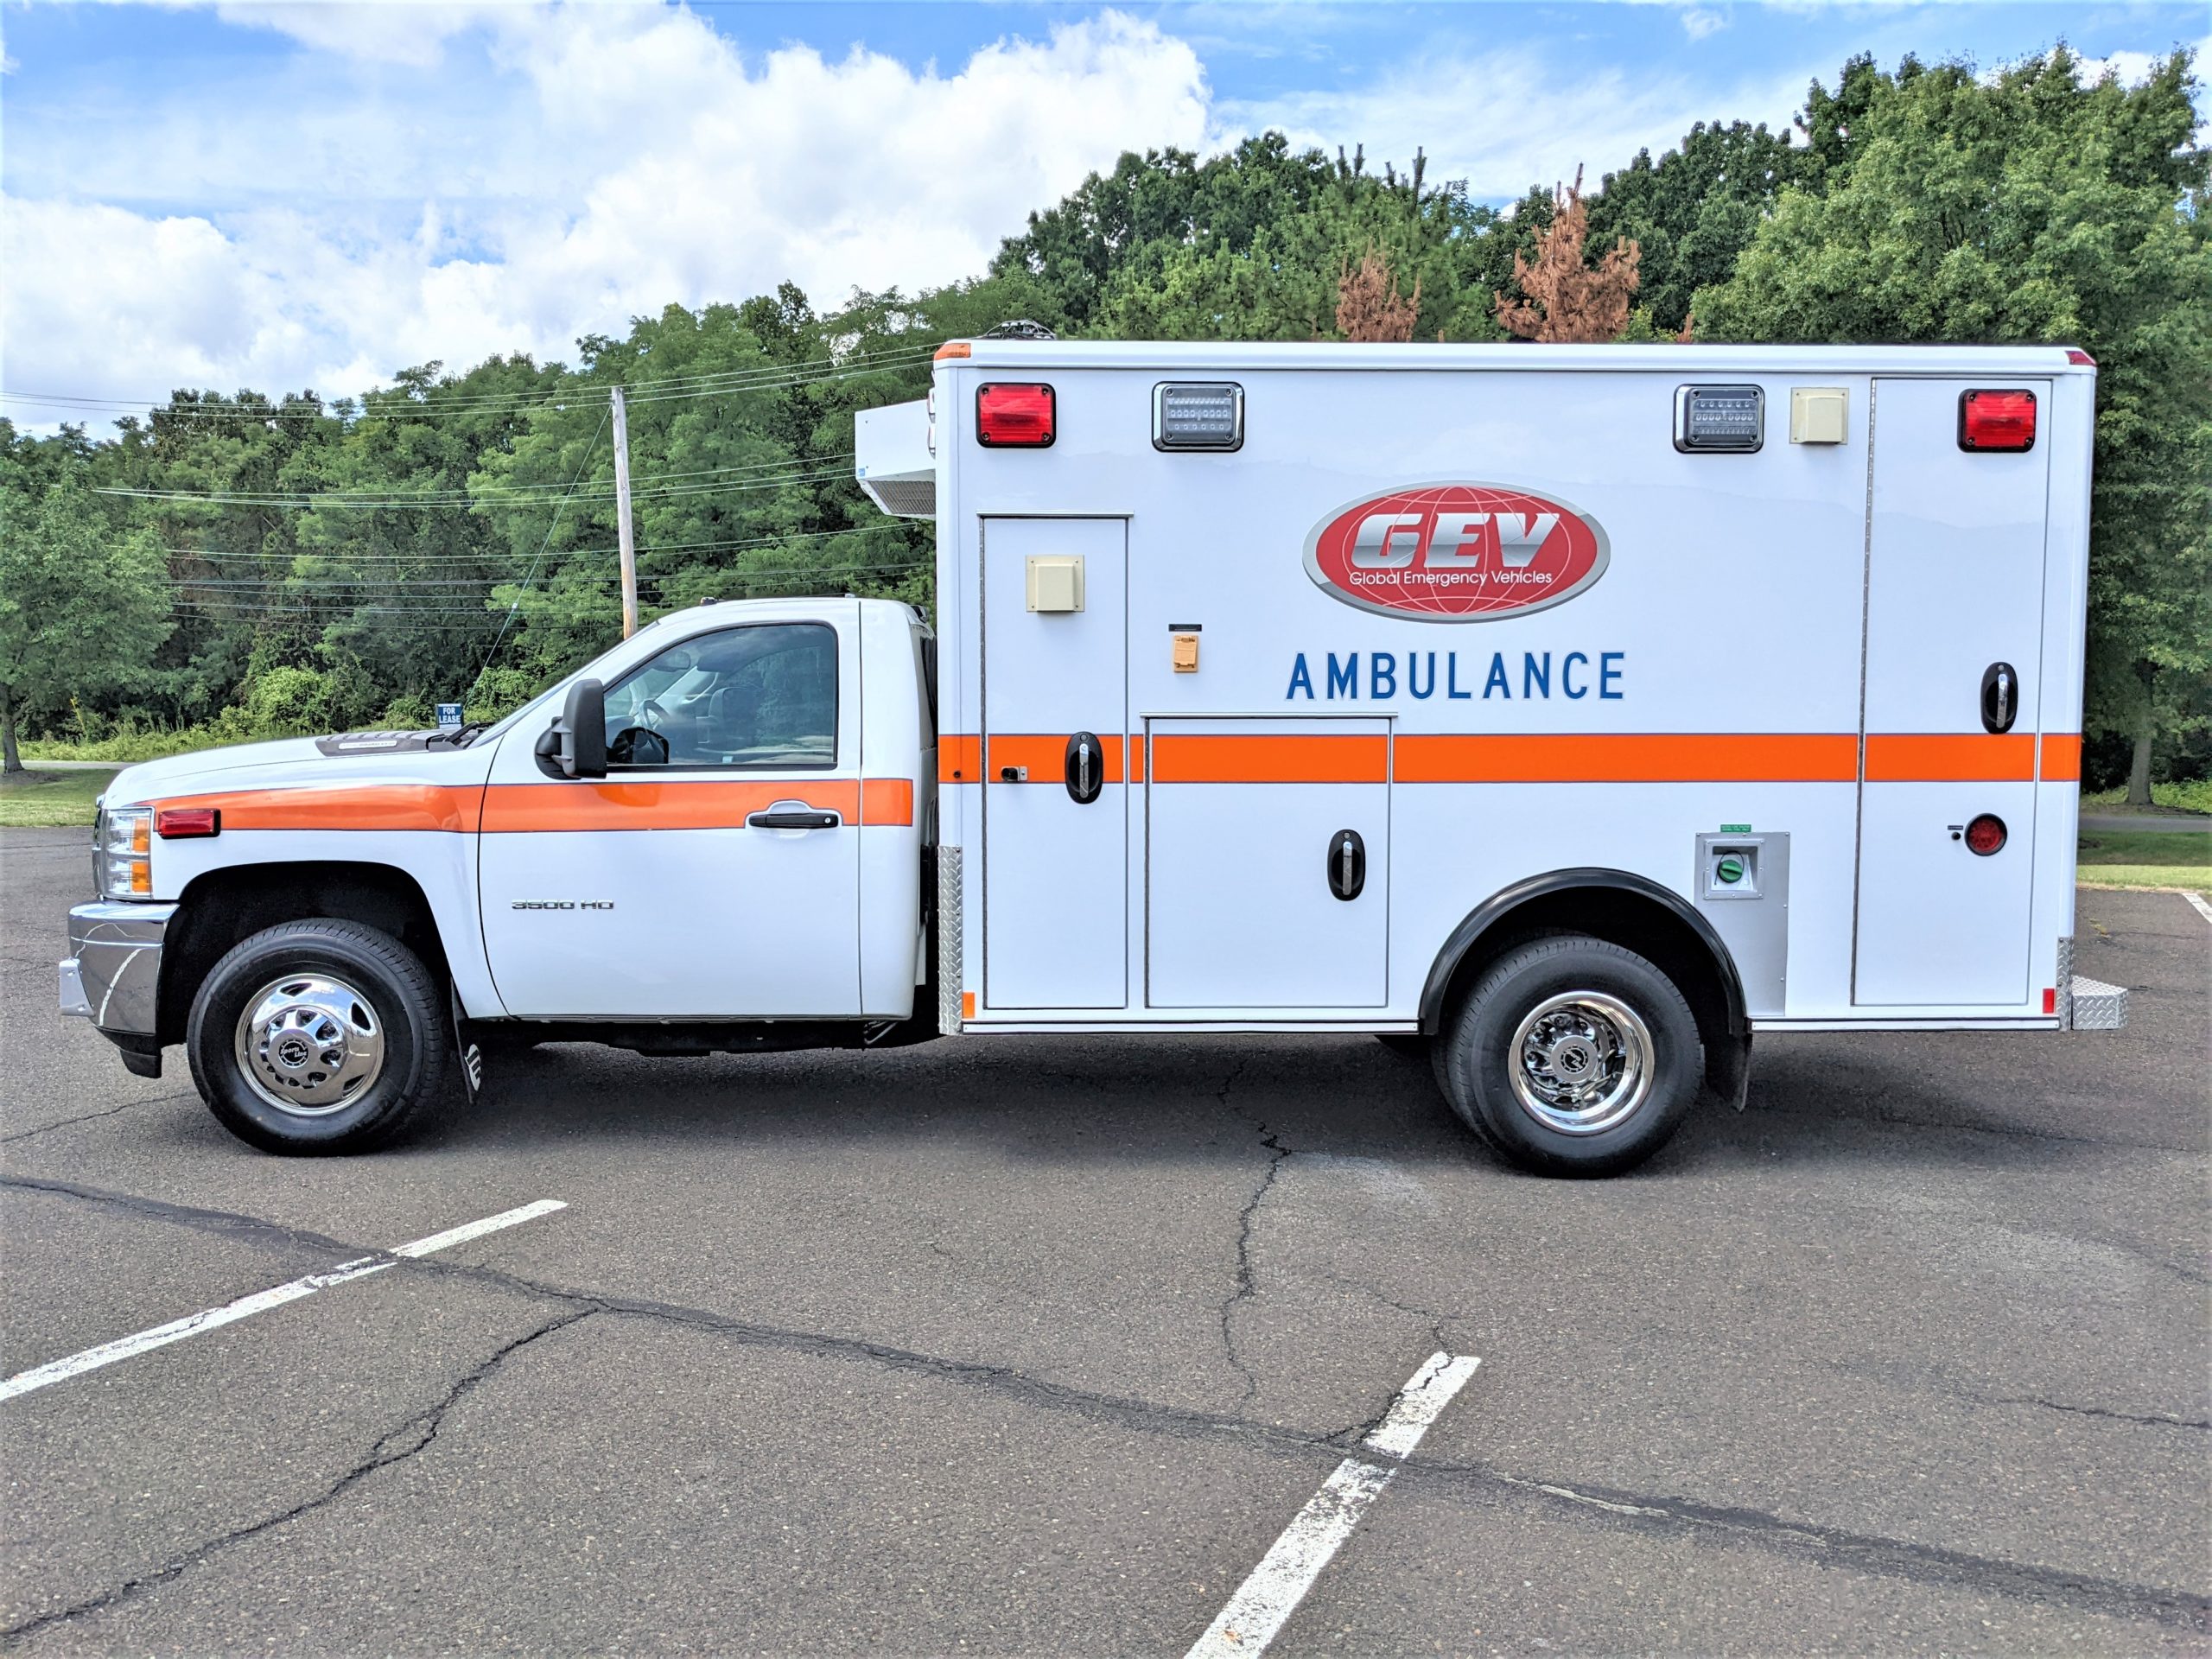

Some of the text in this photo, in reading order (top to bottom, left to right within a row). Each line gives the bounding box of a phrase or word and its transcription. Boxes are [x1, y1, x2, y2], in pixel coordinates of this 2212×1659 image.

[1351, 512, 1560, 569] GEV
[1350, 570, 1552, 588] Global Emergency Vehicles
[1286, 651, 1625, 701] AMBULANCE
[512, 899, 613, 909] 3500 HD
